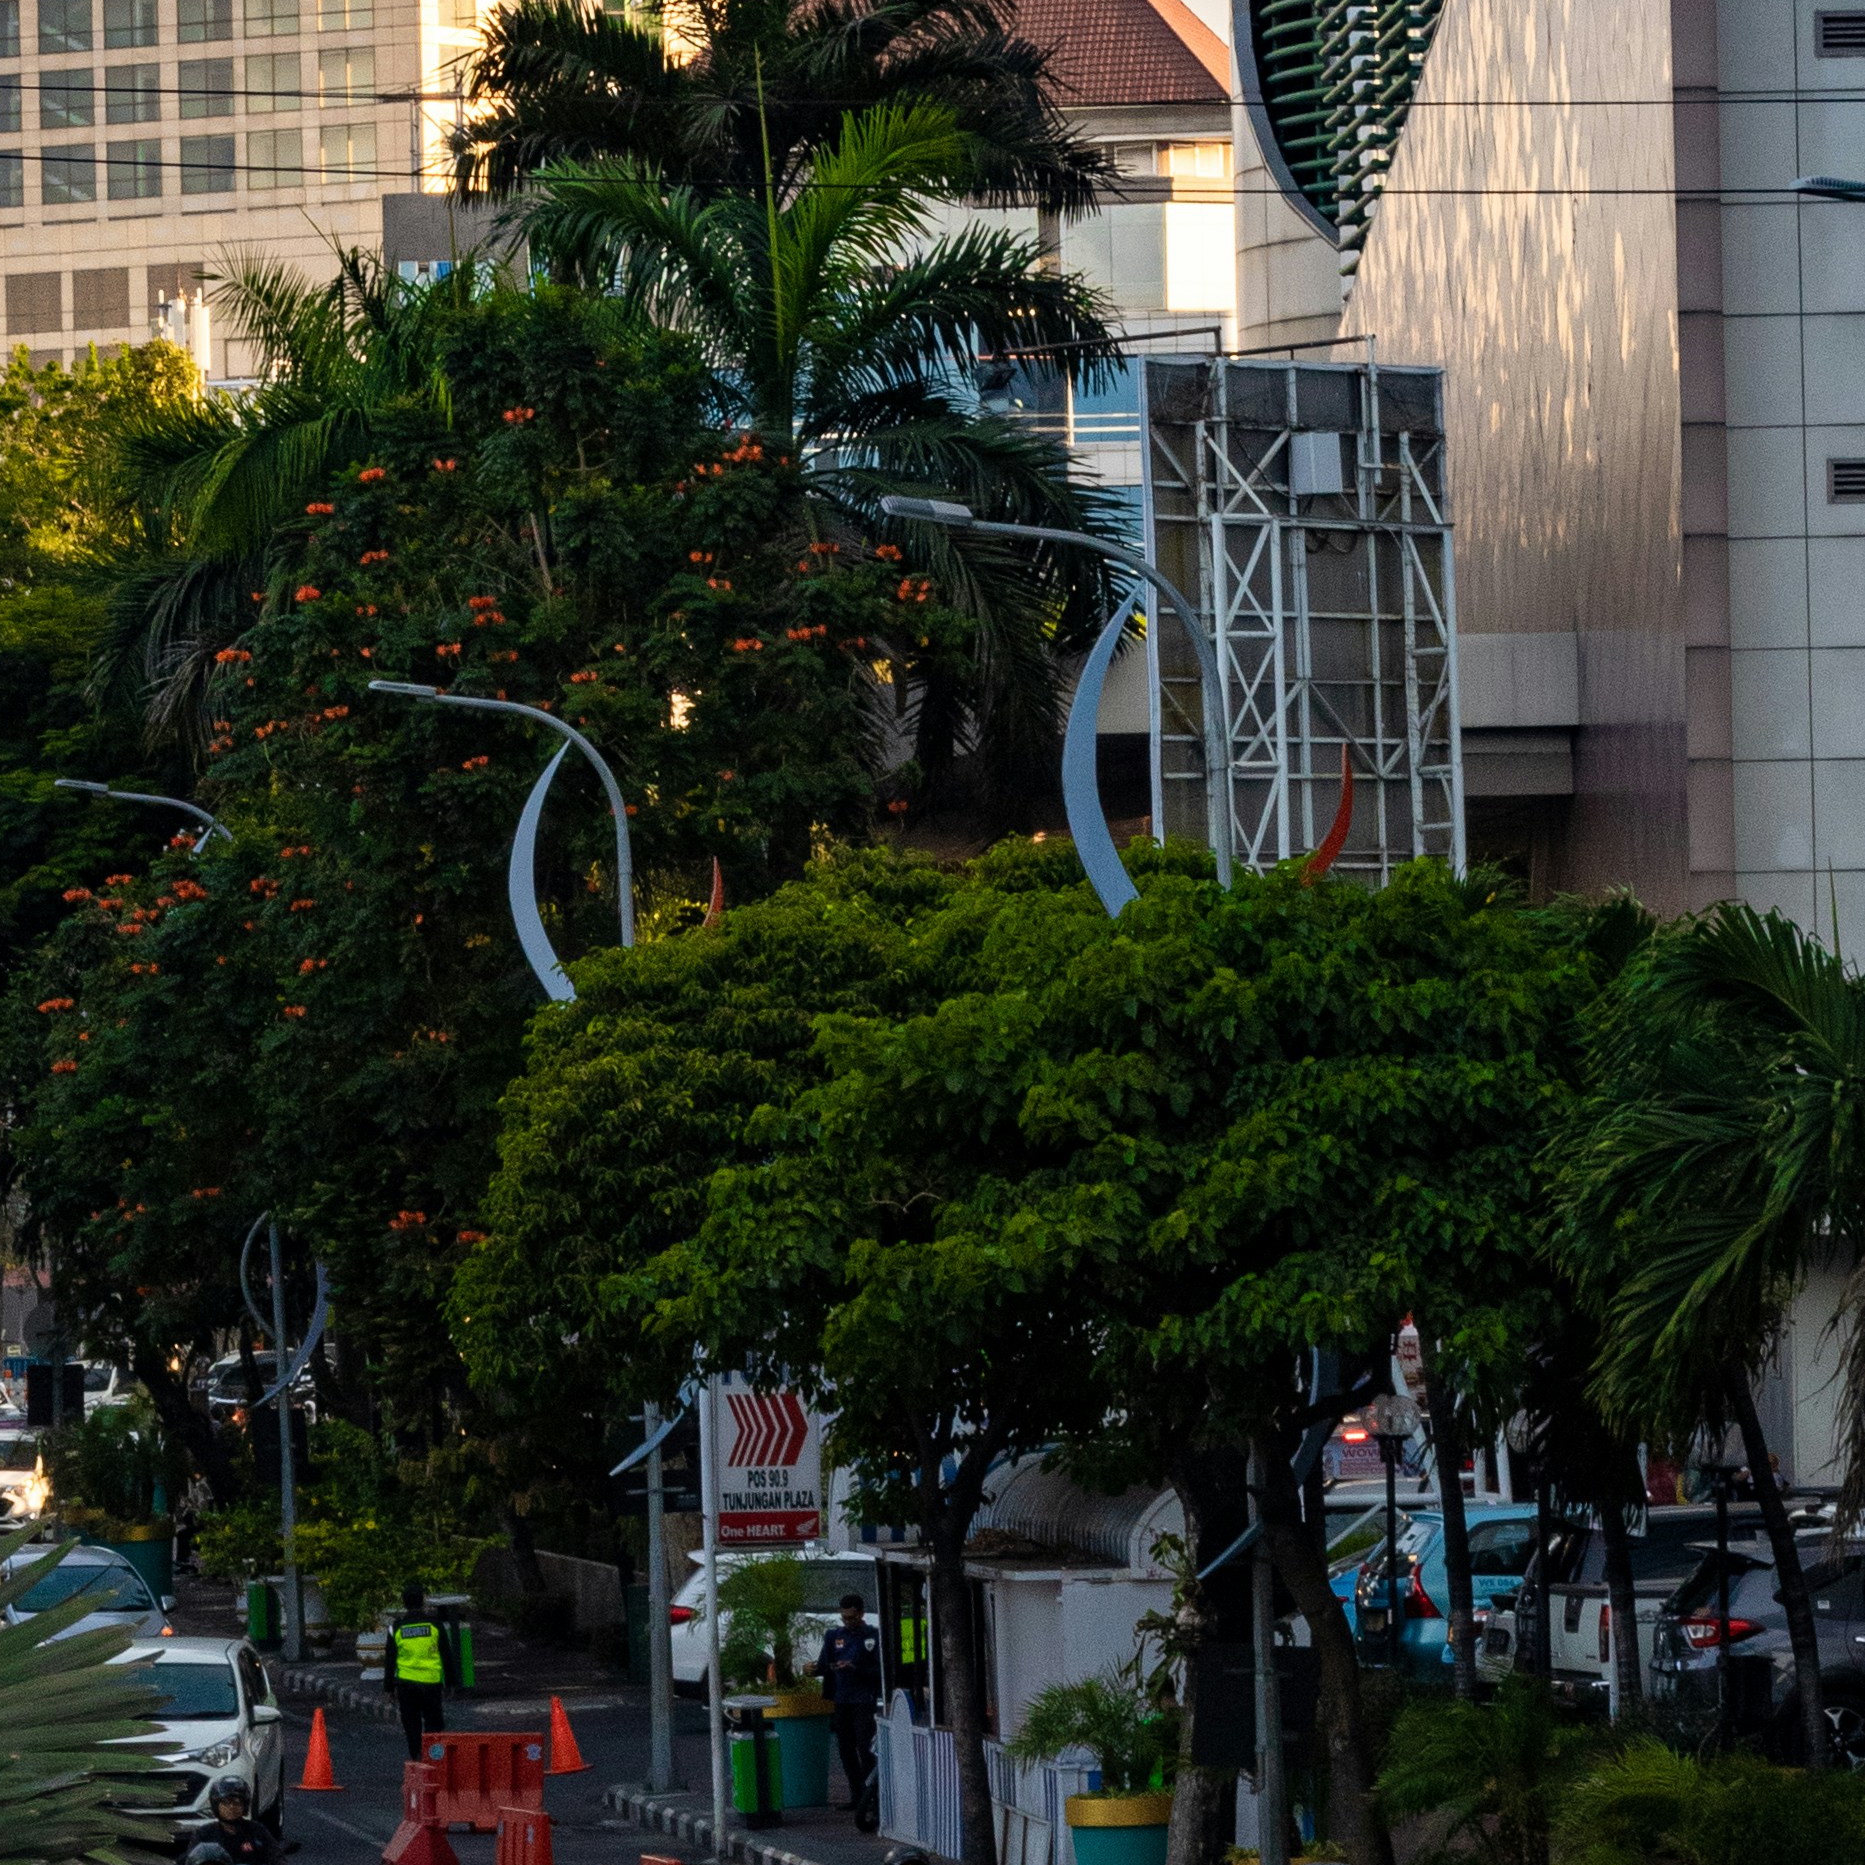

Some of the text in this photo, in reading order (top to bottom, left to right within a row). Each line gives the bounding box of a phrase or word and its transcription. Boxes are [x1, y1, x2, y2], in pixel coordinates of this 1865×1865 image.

[747, 1469, 789, 1488] POS 90.9
[722, 1490, 814, 1511] TUNJUNGAN PLAZA
[721, 1525, 744, 1537] One
